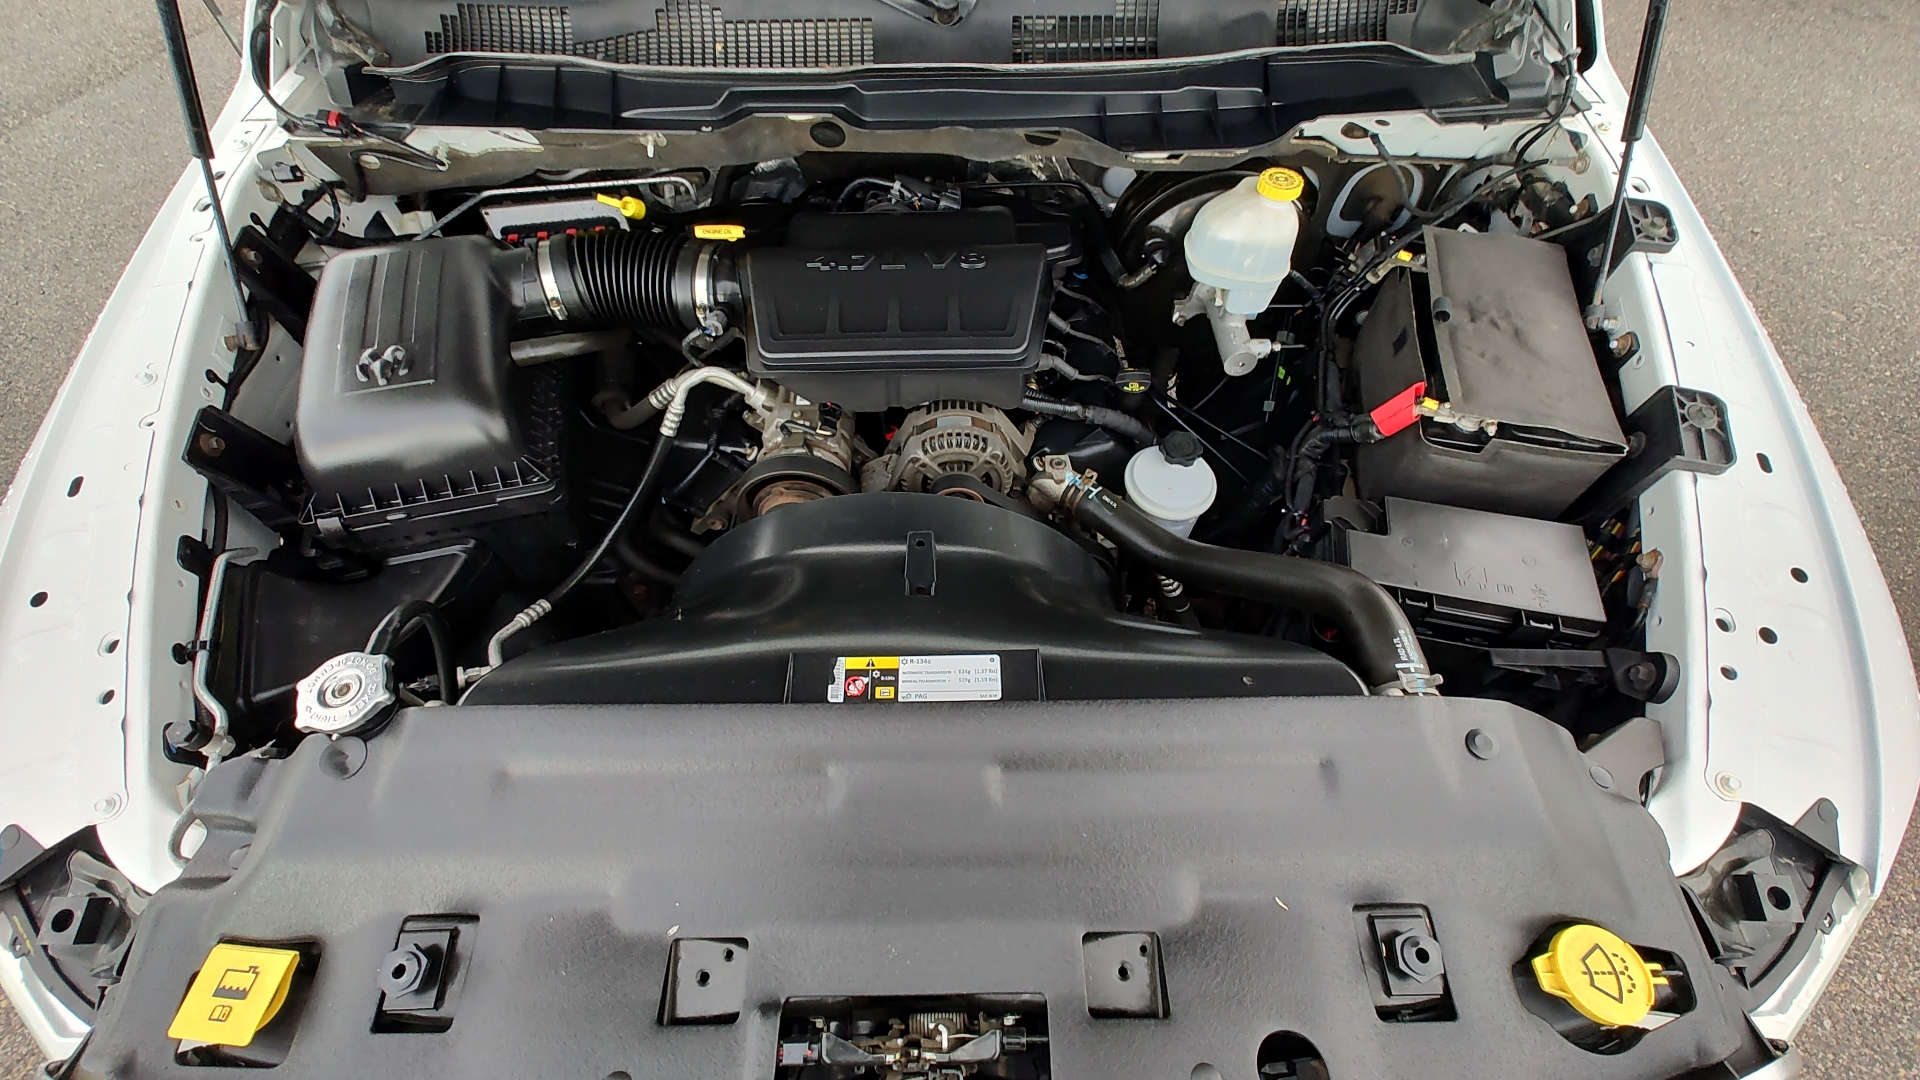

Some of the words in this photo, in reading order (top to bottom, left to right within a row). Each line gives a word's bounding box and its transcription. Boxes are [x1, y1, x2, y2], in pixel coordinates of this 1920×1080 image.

[923, 252, 987, 270] V8
[349, 656, 369, 668] NOT
[309, 711, 338, 723] TIGHT
